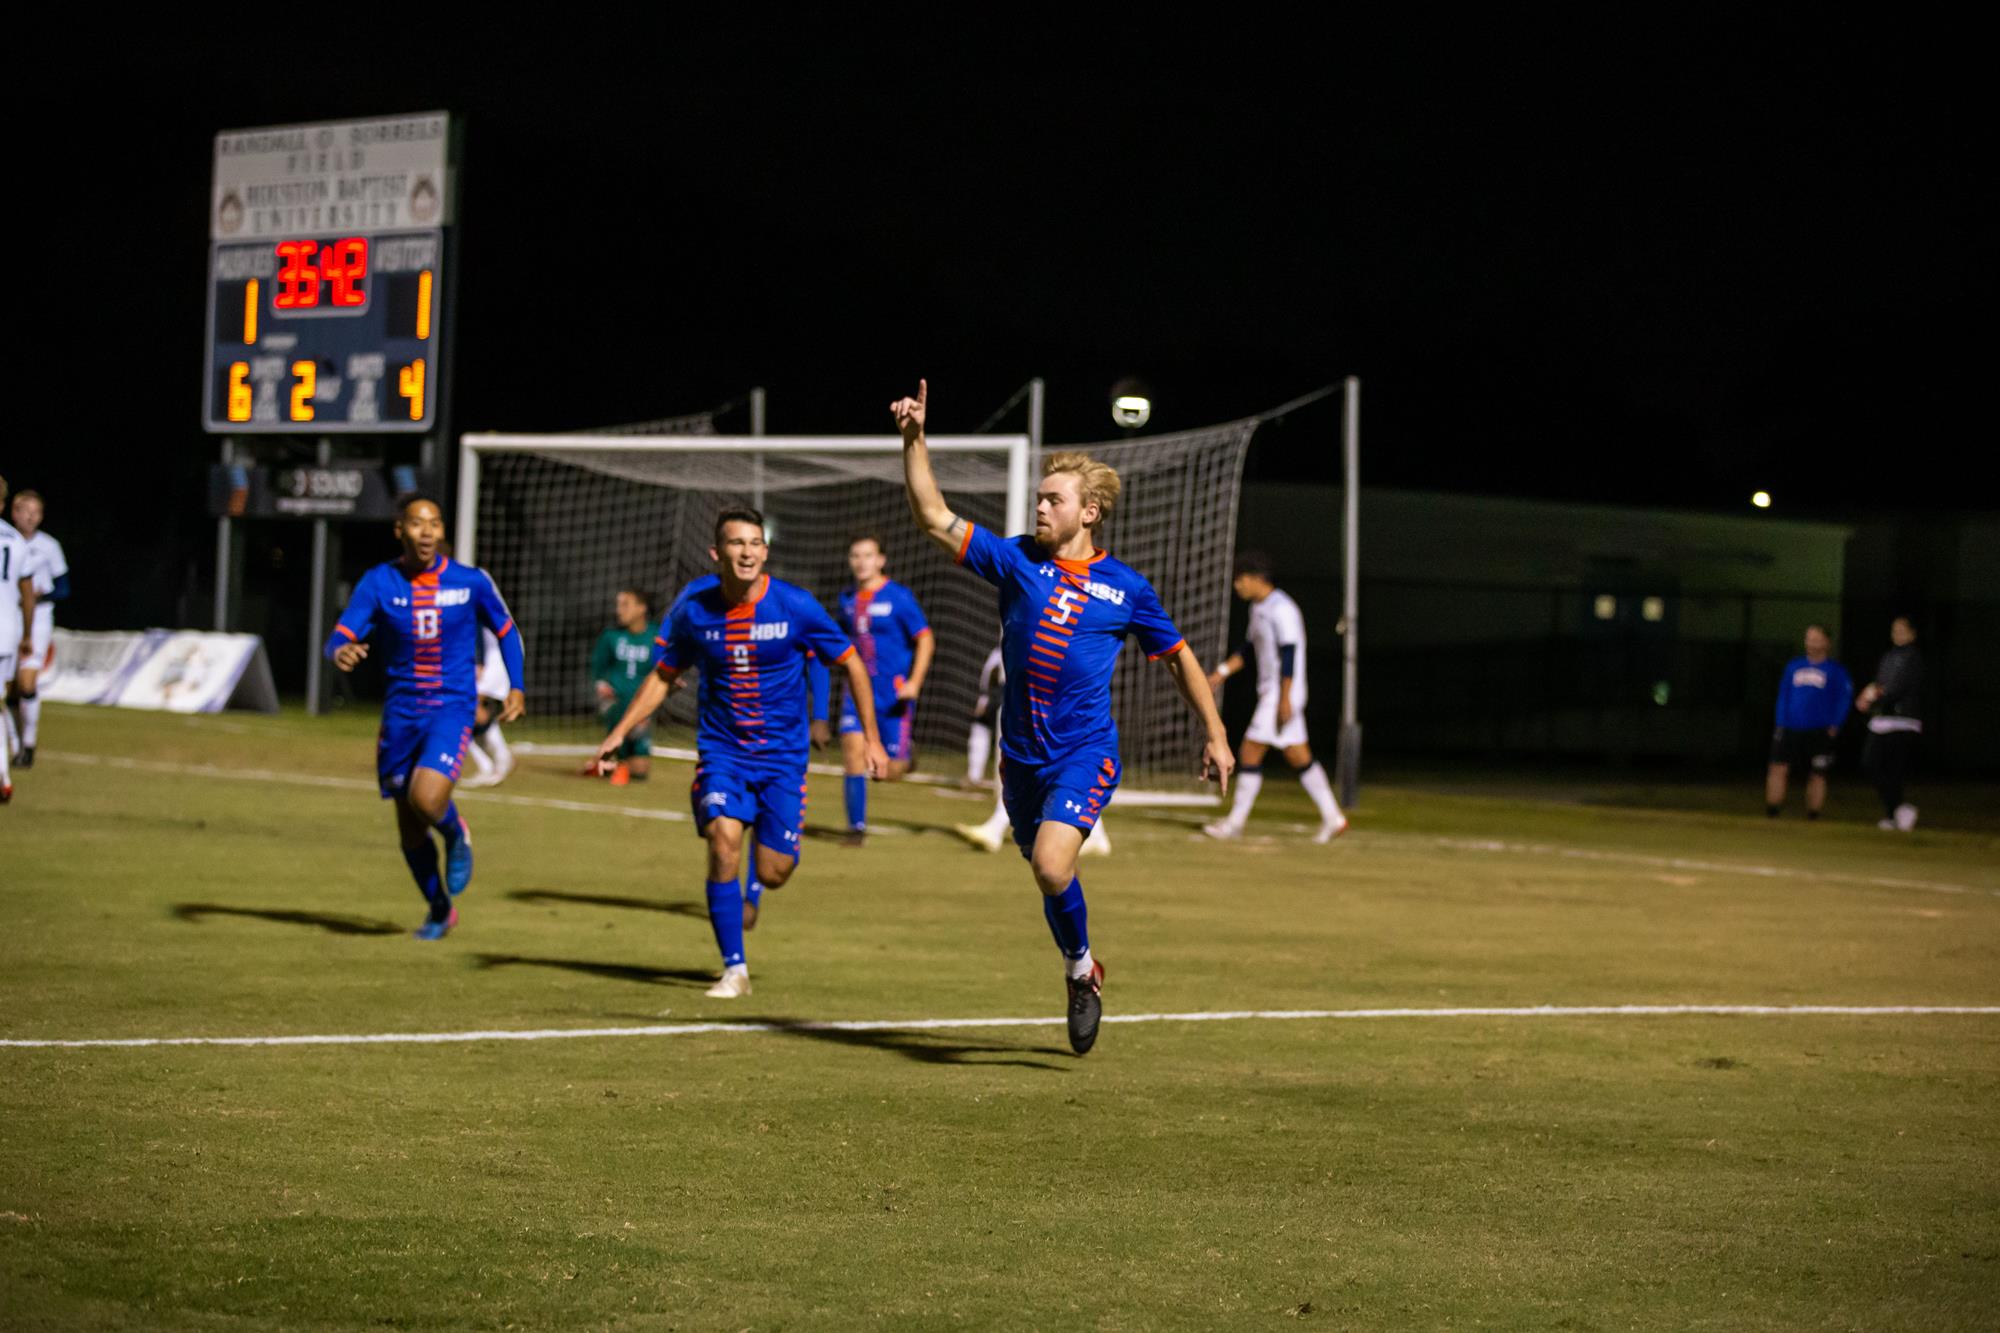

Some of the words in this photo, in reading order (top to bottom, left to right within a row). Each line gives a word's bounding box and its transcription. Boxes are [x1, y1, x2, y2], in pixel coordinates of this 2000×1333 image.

[244, 277, 259, 345] 1
[416, 270, 432, 340] 1
[228, 361, 252, 422] 6
[290, 360, 317, 421] 2
[399, 358, 426, 421] 4
[1050, 590, 1078, 625] 5
[1083, 580, 1126, 606] HBU
[416, 608, 438, 639] 13
[749, 621, 789, 642] HBU
[733, 644, 750, 672] 9
